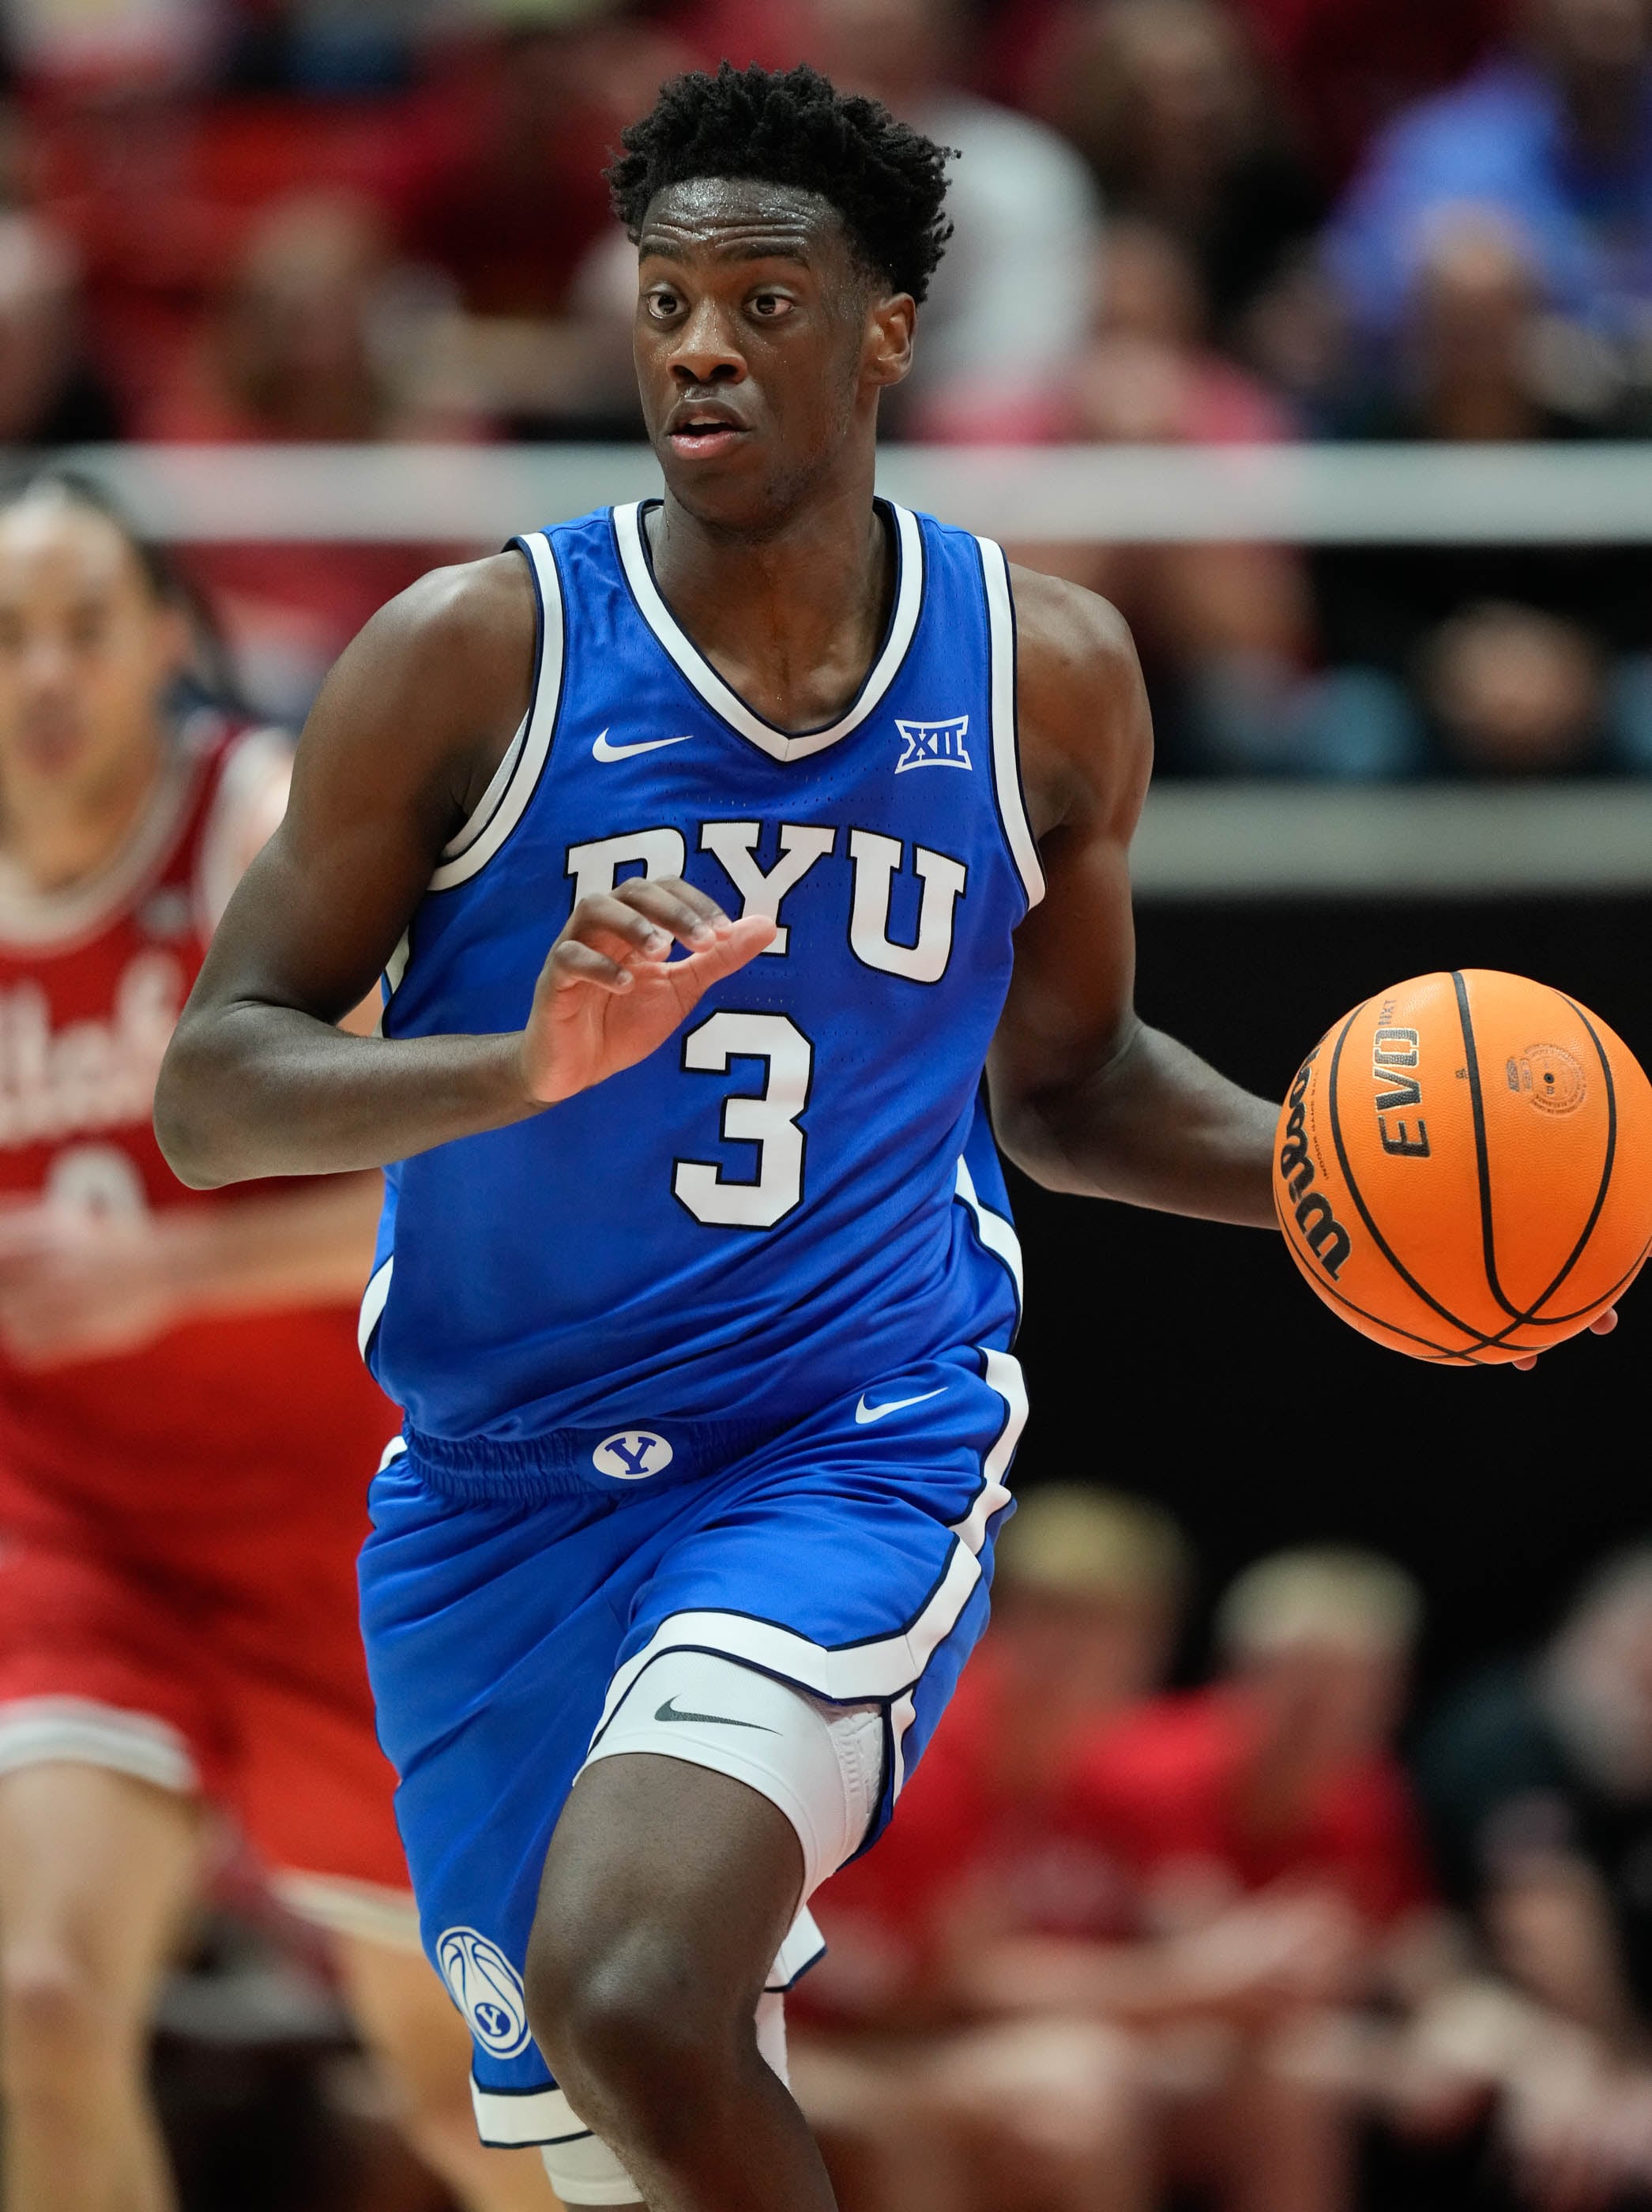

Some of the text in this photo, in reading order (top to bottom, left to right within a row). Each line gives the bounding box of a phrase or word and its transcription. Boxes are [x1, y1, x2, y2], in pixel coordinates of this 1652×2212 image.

[896, 717, 970, 772] XII
[1373, 1028, 1431, 1157] EVO
[671, 1008, 815, 1232] 3
[1313, 1136, 1330, 1180] INDOOR
[604, 1436, 657, 1475] Y
[476, 2005, 502, 2035] Y
